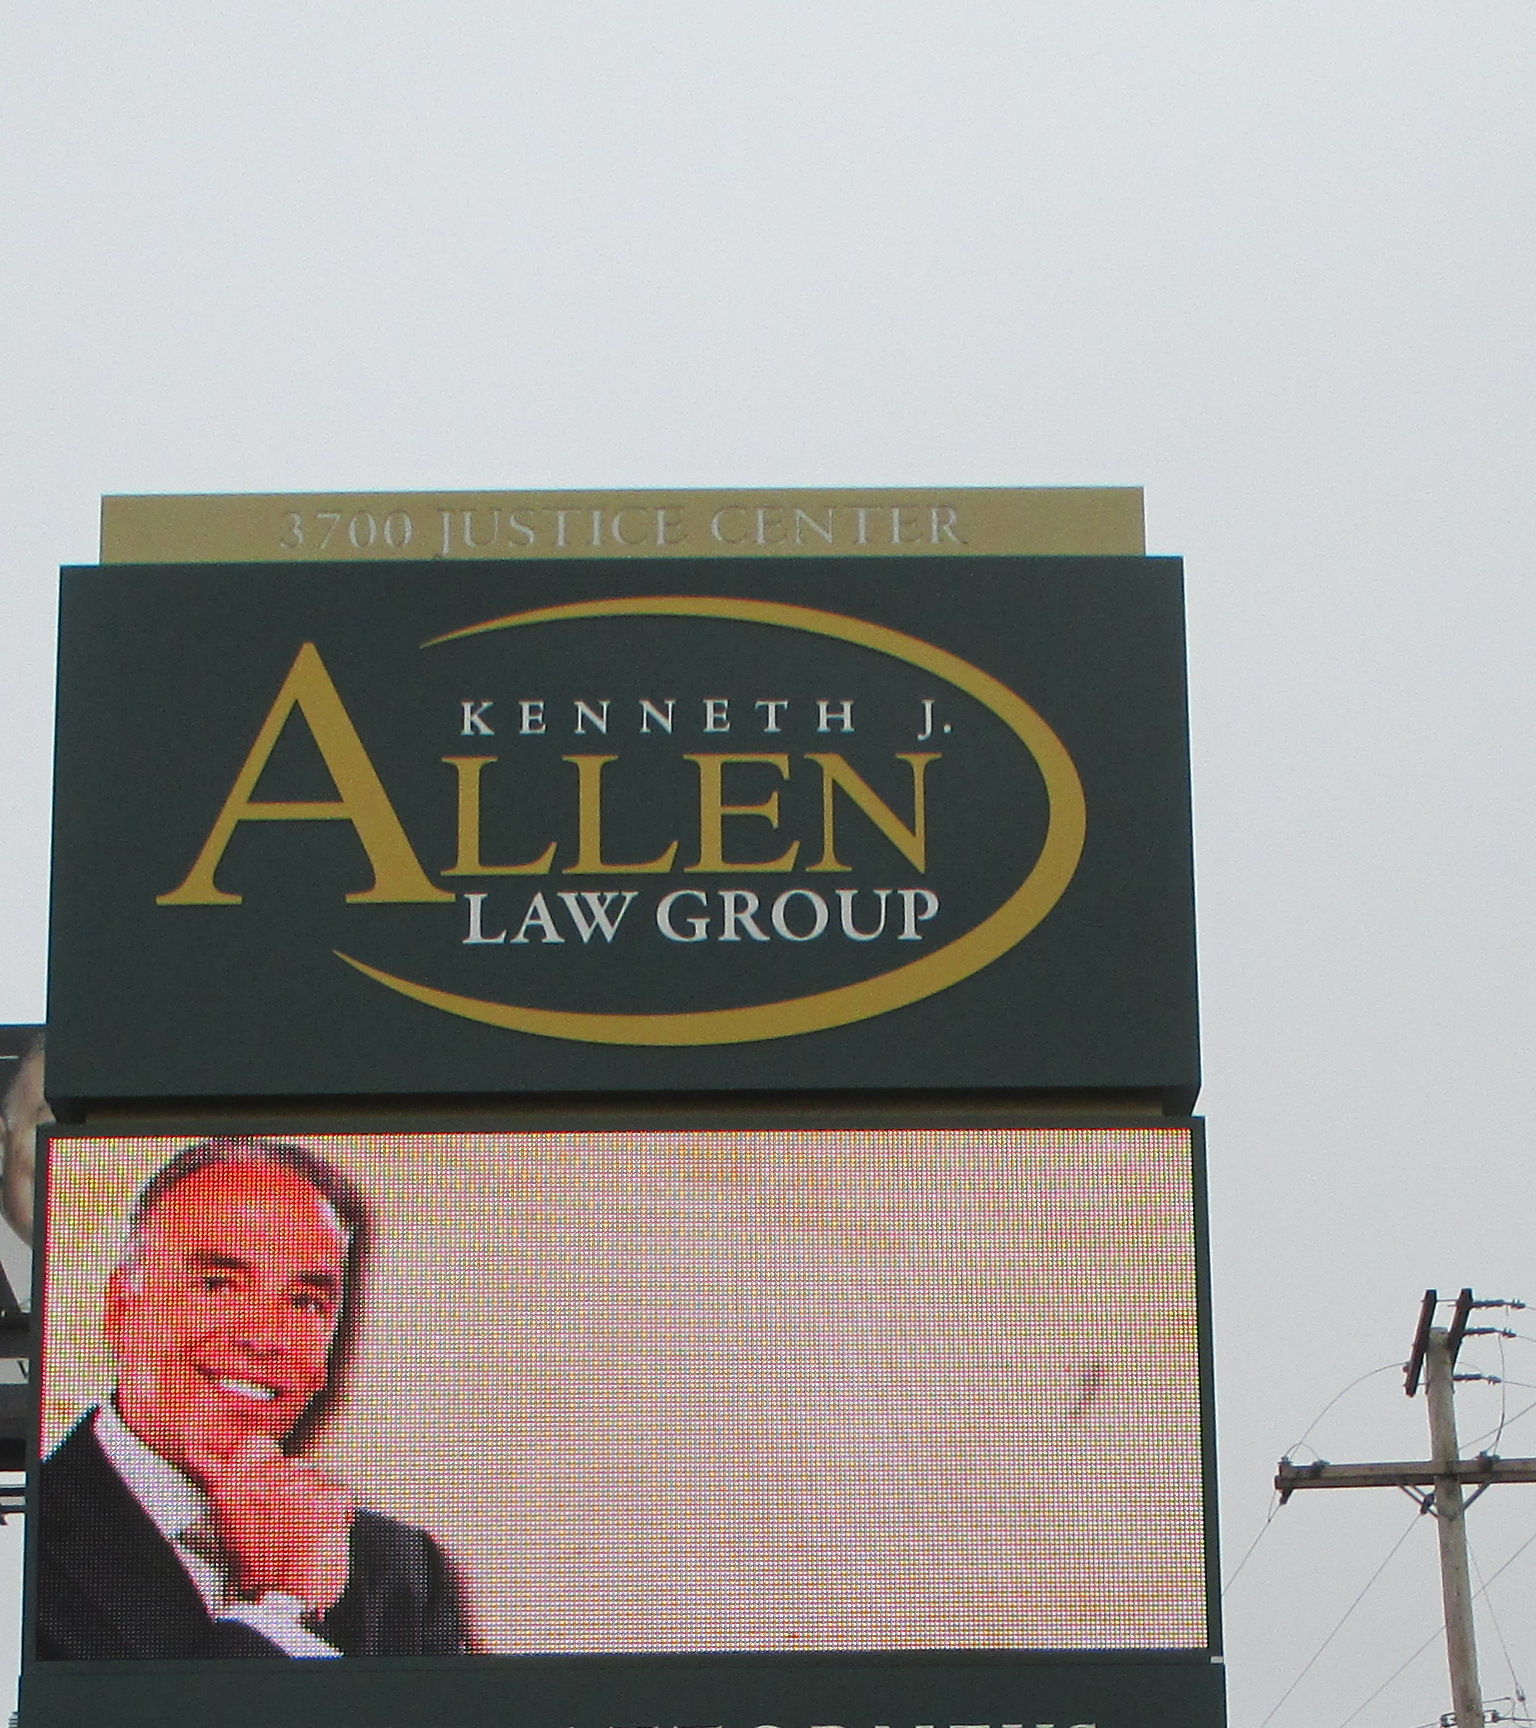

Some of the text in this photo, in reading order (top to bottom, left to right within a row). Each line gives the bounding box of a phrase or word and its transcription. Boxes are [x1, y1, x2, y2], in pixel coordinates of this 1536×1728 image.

[280, 505, 967, 559] 3700 JUSTICE CENTER
[461, 699, 953, 742] KENNETH J.
[156, 642, 942, 905] ALLEN
[462, 889, 940, 945] LAW GROUP
